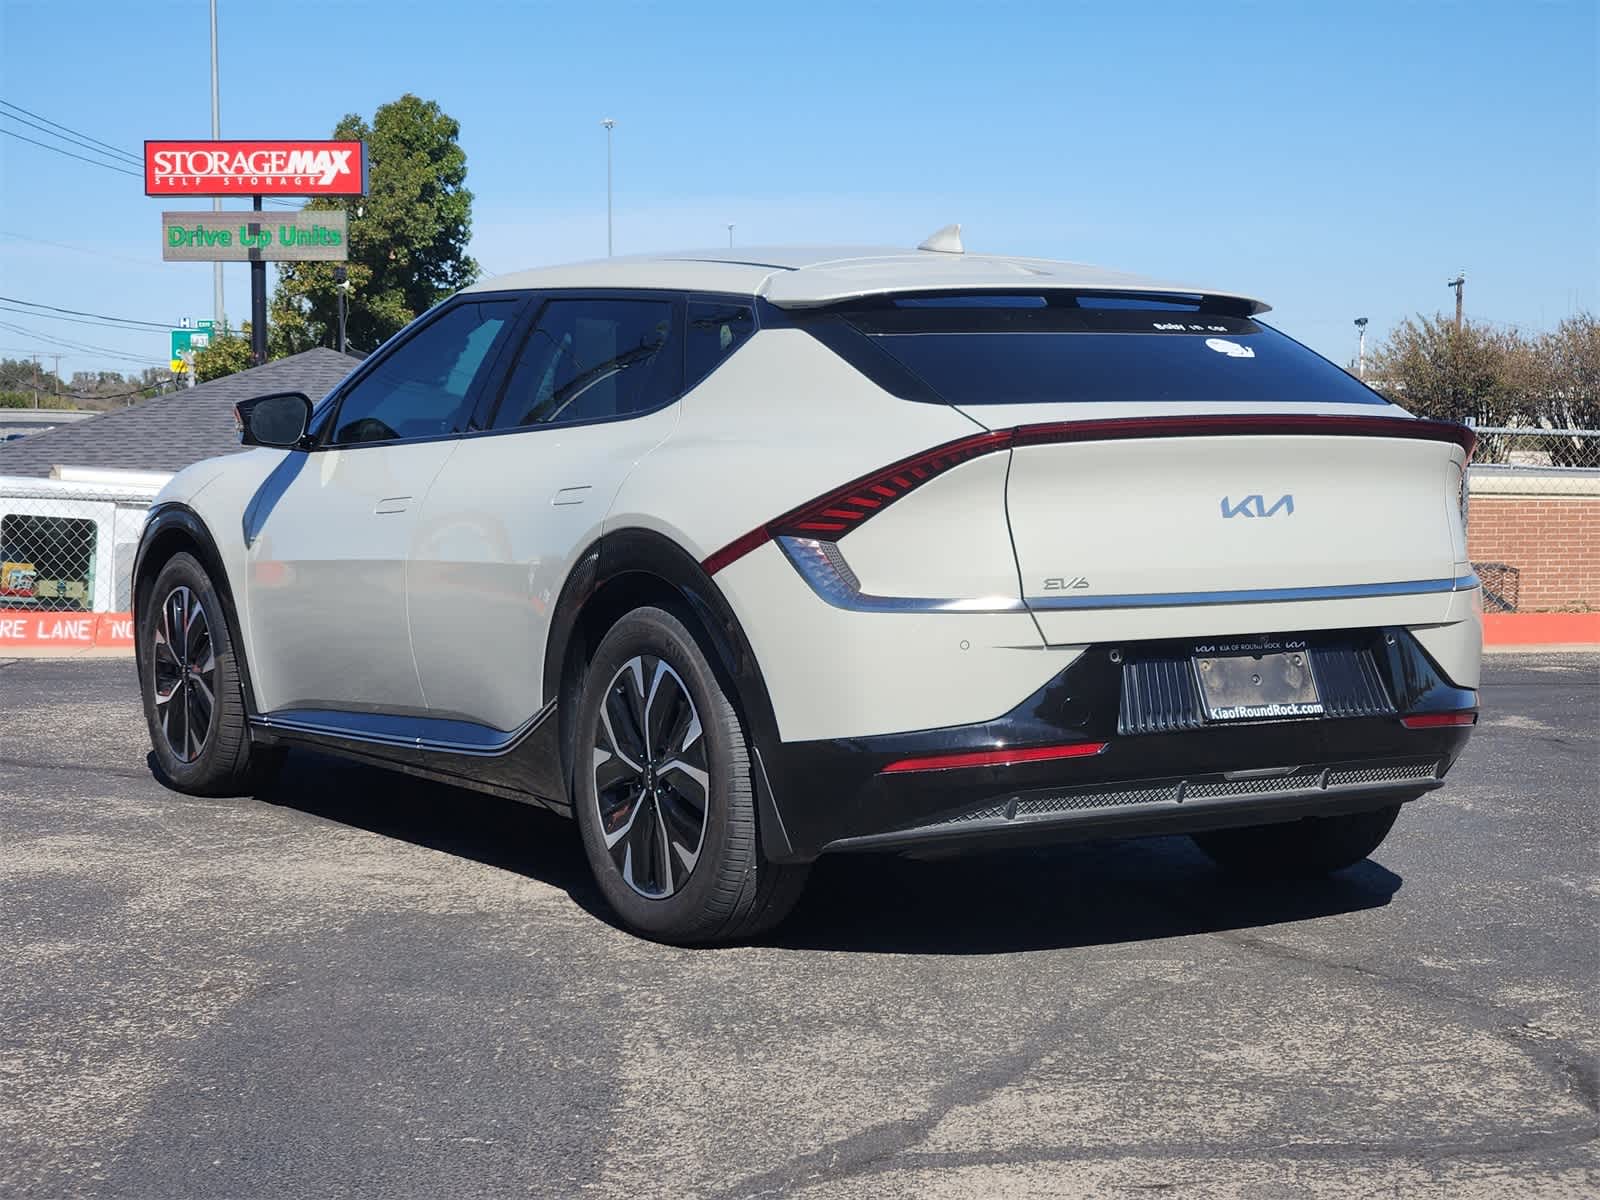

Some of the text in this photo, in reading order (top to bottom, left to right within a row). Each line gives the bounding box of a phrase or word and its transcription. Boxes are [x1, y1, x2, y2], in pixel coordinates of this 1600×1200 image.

[155, 176, 316, 185] SELF STORAGE
[168, 224, 342, 249] Drive Up Units
[1220, 494, 1295, 519] KIA
[1043, 577, 1090, 591] EV6
[37, 619, 92, 641] LANE
[1210, 703, 1324, 720] KiaofRoundRock.com
